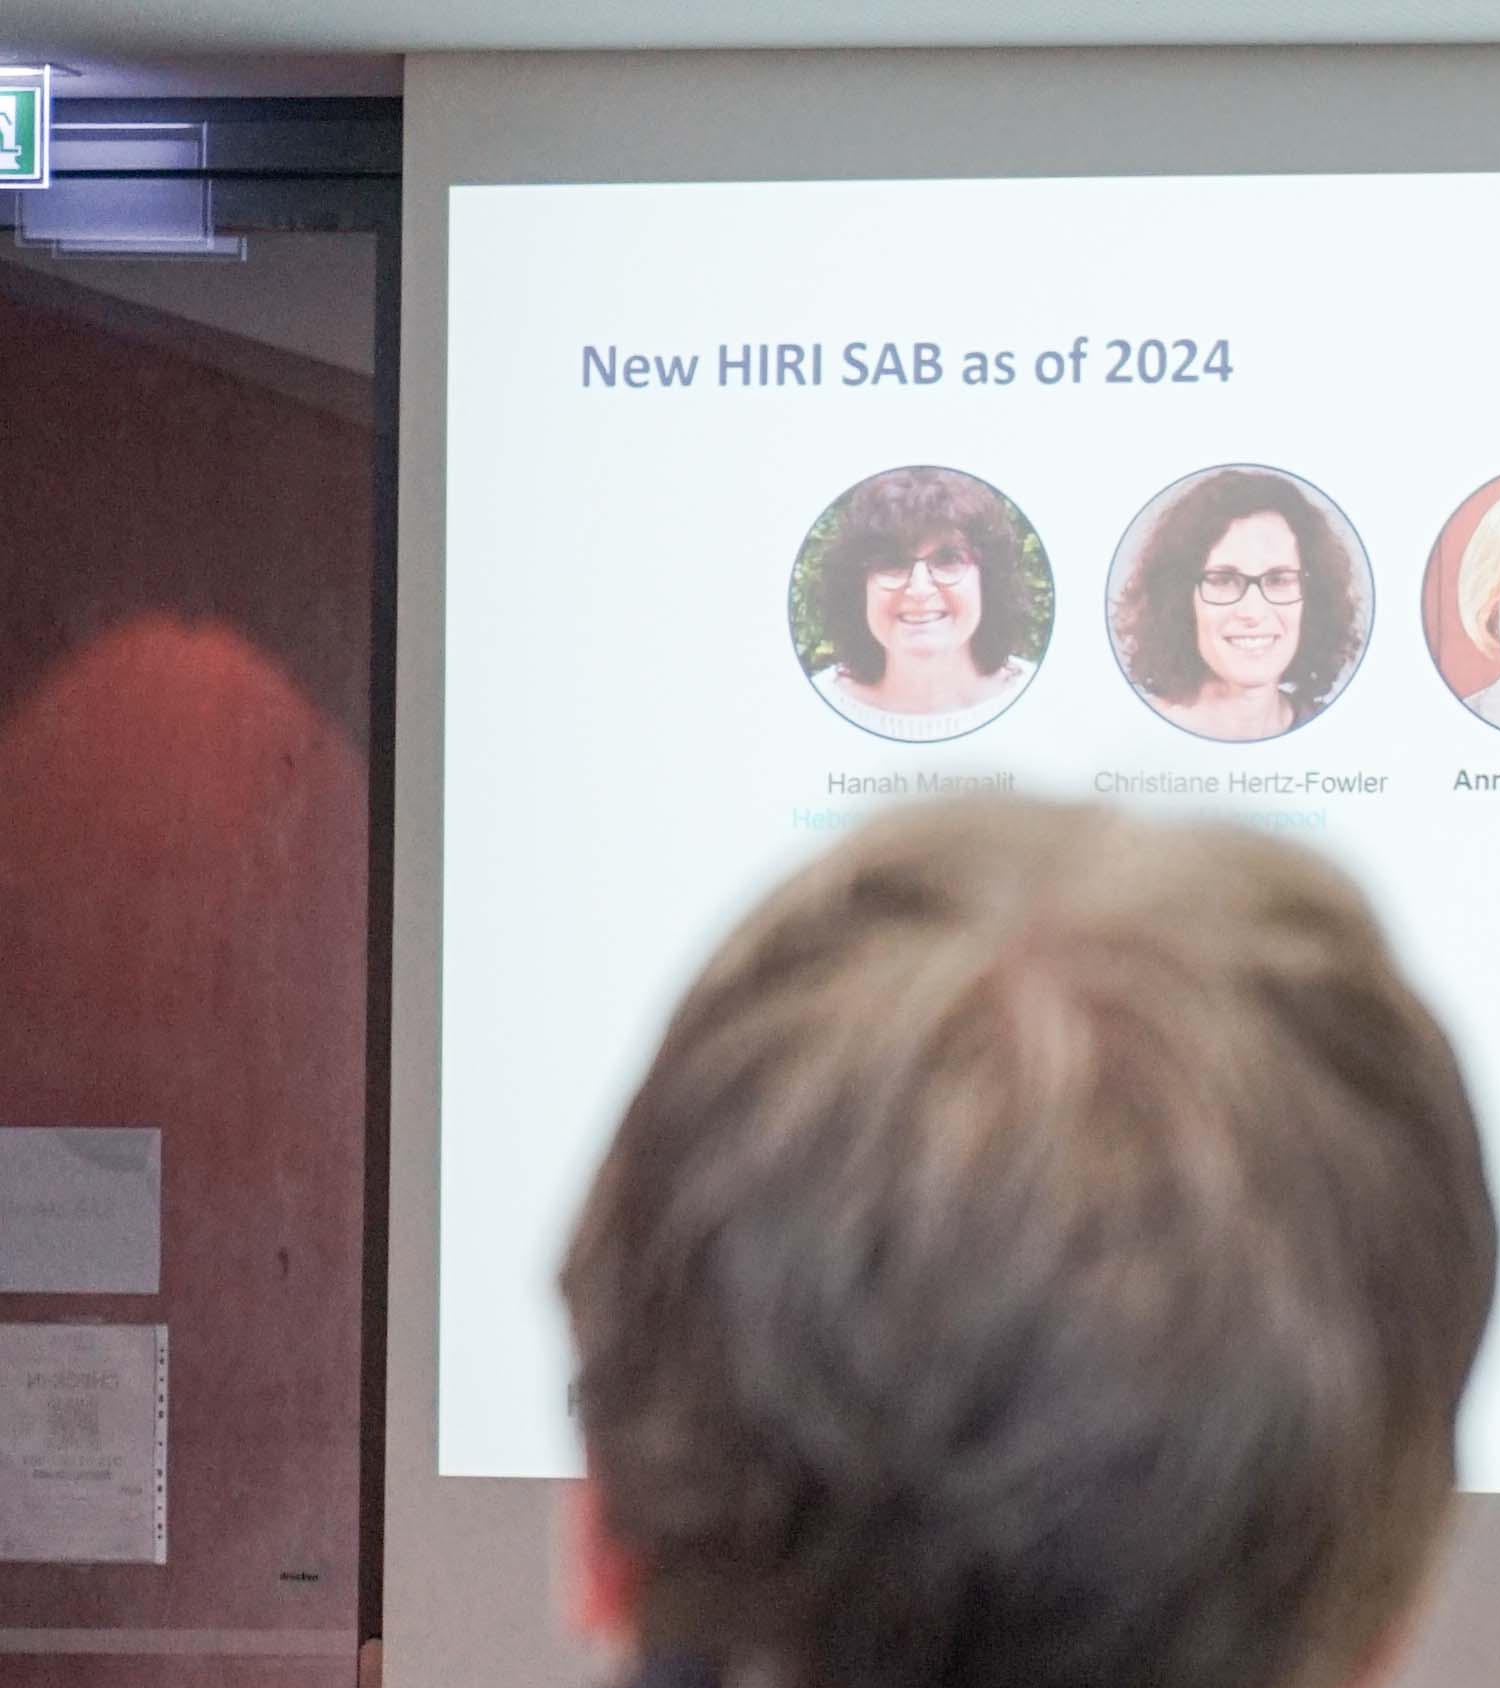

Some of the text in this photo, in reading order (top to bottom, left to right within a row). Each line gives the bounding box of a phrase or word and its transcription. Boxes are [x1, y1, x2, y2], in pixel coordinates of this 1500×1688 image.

[581, 336, 1233, 388] New HIRI SAB as of 2024
[827, 771, 908, 795] Hanah
[1094, 771, 1388, 794] Christiane Hertz-Fowler
